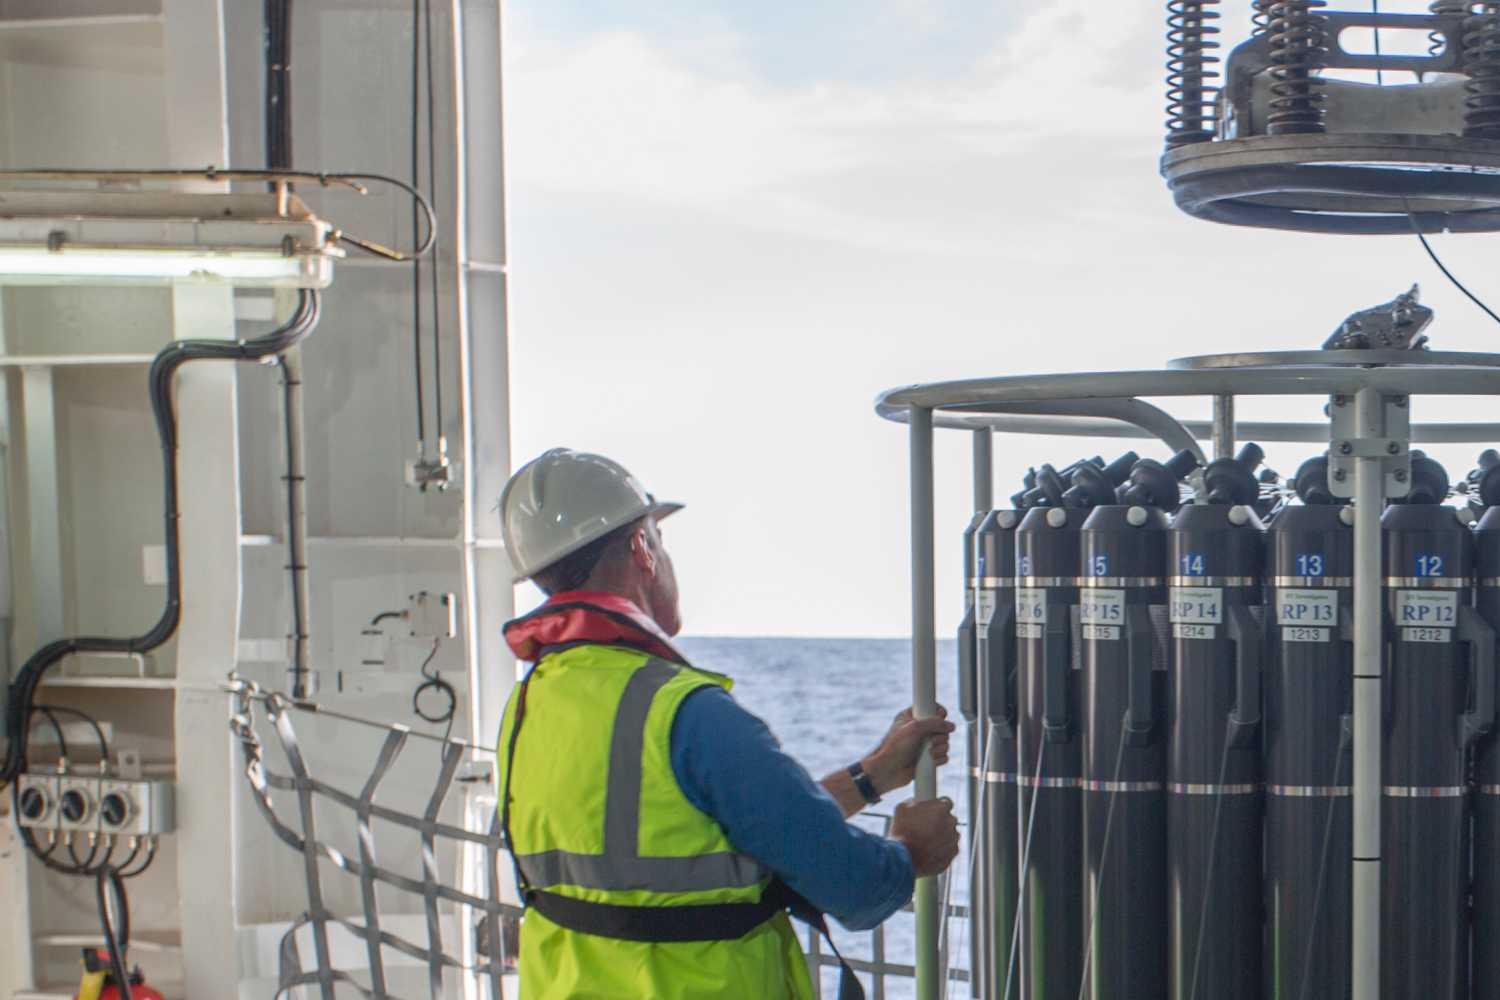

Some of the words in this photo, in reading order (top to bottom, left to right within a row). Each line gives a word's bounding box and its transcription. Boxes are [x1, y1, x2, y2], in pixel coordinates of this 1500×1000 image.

[1182, 555, 1203, 575] 14
[1298, 555, 1322, 575] 13
[1418, 556, 1442, 576] 12
[1102, 604, 1120, 620] 15
[1172, 602, 1192, 618] RP
[1198, 602, 1217, 618] 14
[1283, 604, 1308, 620] RP
[1313, 605, 1333, 621] 13
[1402, 605, 1430, 621] RP
[1435, 606, 1453, 621] 12
[1291, 629, 1321, 641] 1213
[1412, 629, 1442, 641] 1212
